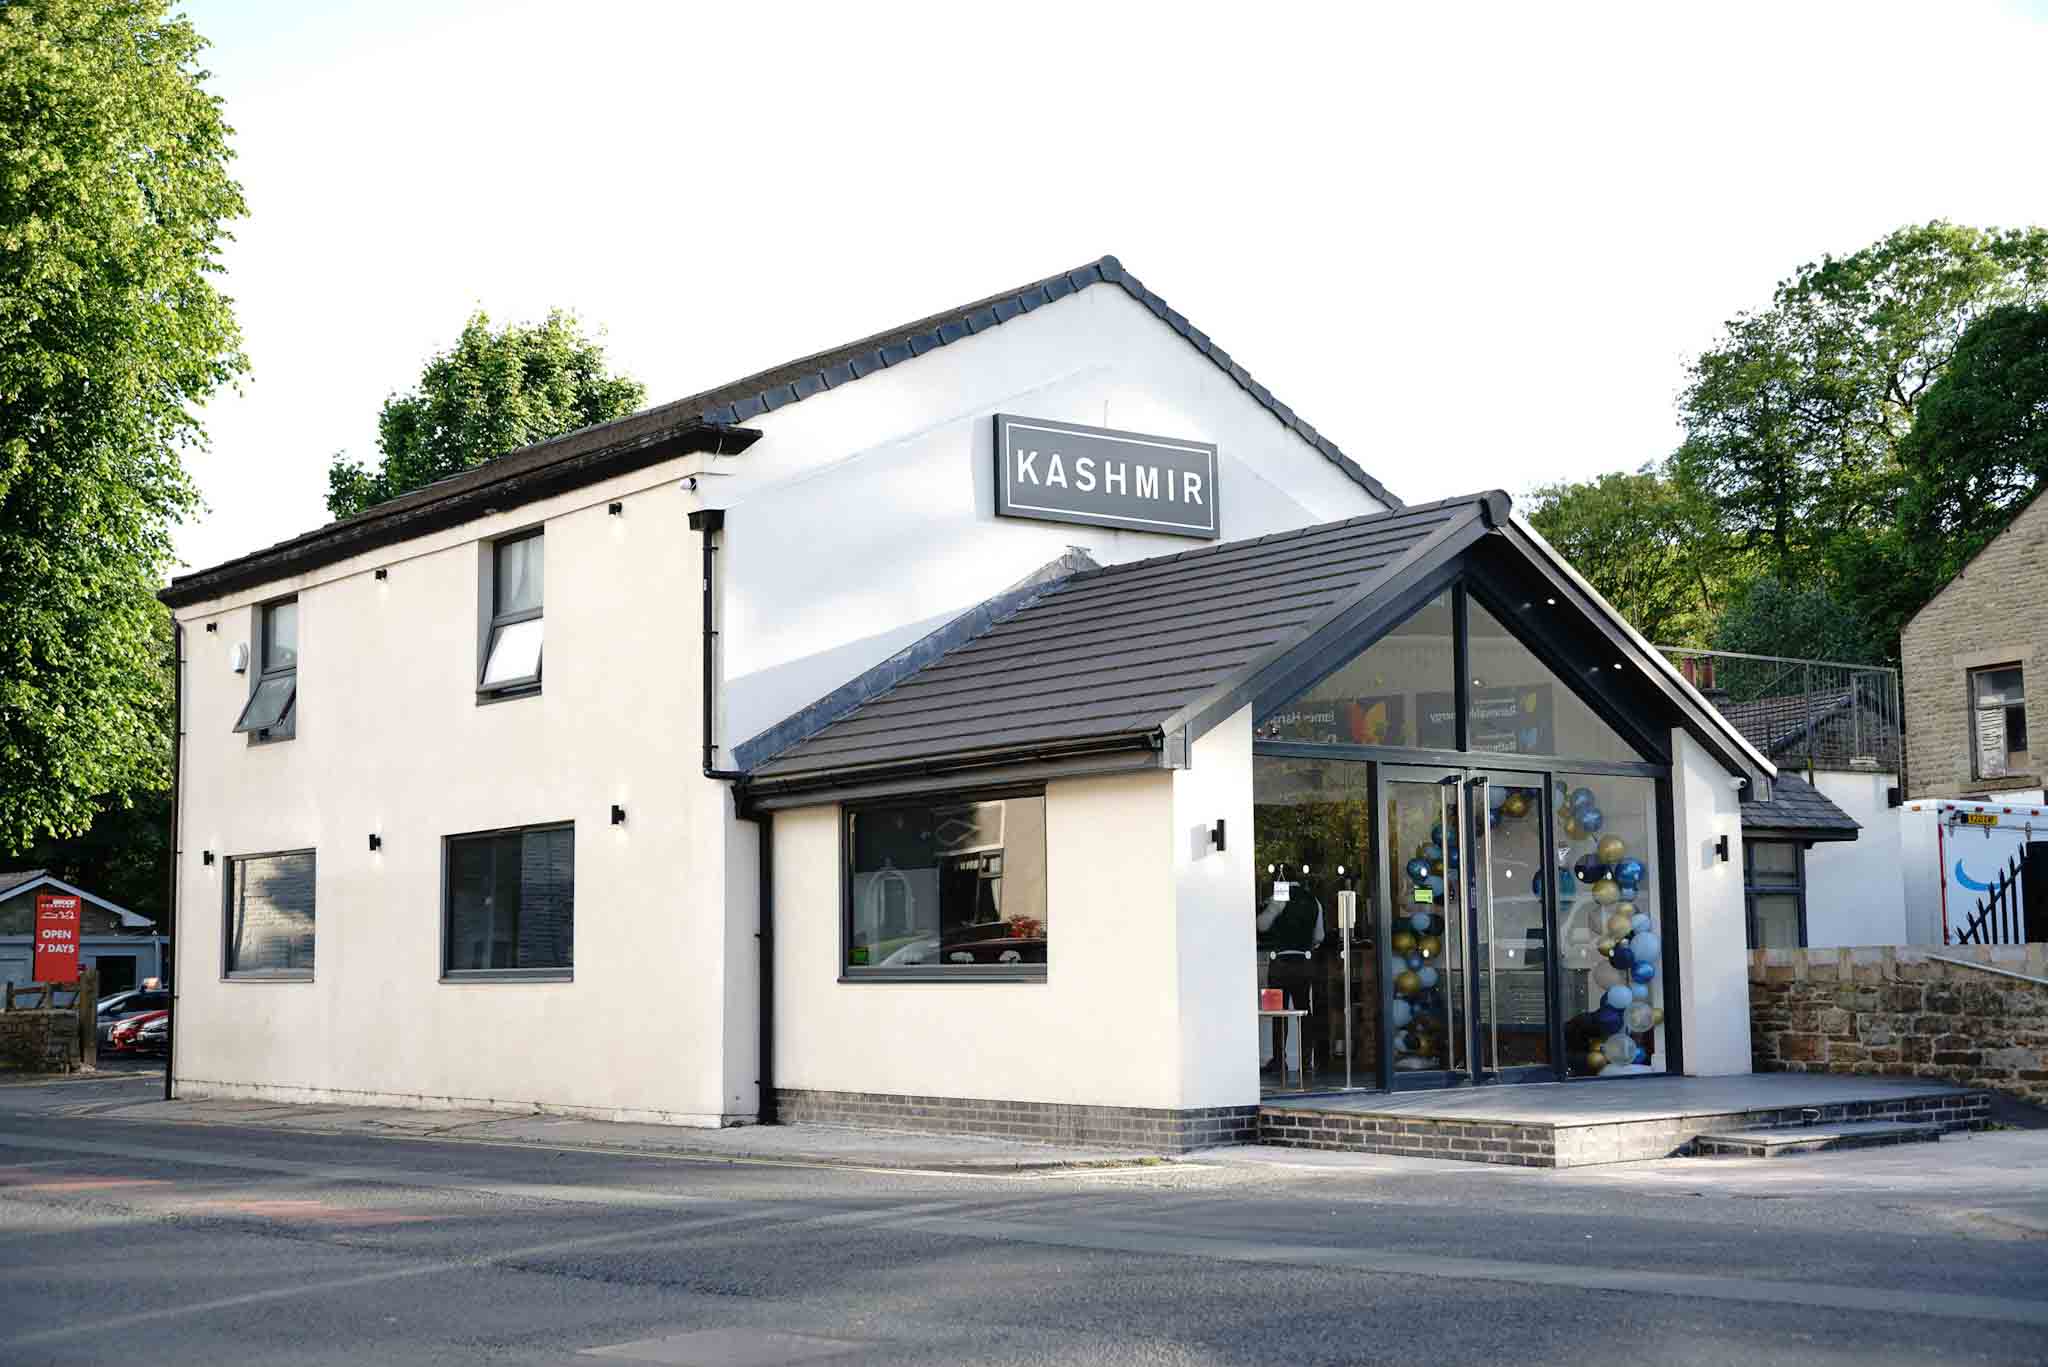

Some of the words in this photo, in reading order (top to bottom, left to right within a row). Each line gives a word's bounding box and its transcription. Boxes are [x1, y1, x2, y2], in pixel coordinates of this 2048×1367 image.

[1016, 449, 1203, 504] KASHMIR
[42, 929, 71, 939] OPEN
[38, 944, 46, 953] 7
[48, 944, 74, 953] DAYS
